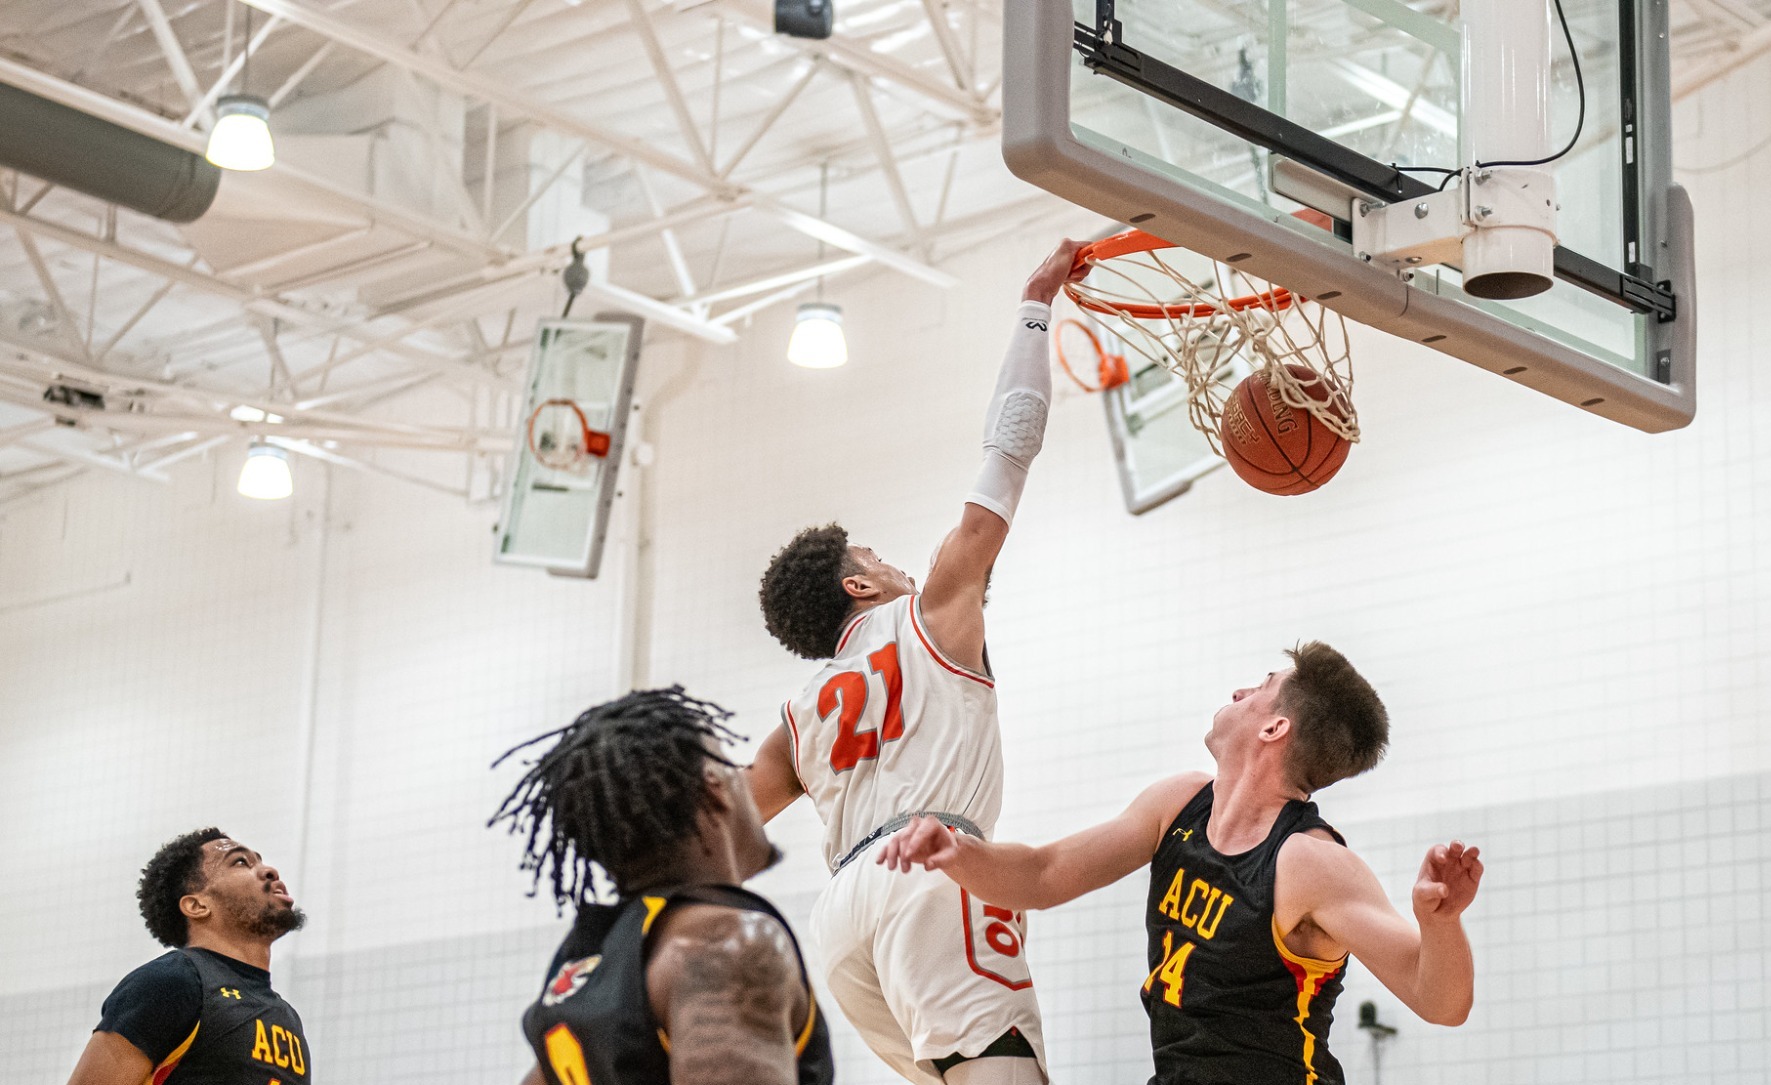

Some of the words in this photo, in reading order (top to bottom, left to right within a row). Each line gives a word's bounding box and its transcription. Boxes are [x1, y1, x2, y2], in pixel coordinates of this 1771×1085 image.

[816, 641, 905, 776] 21
[1158, 867, 1235, 940] ACU
[1143, 930, 1196, 1008] 14
[251, 1018, 306, 1076] ACU
